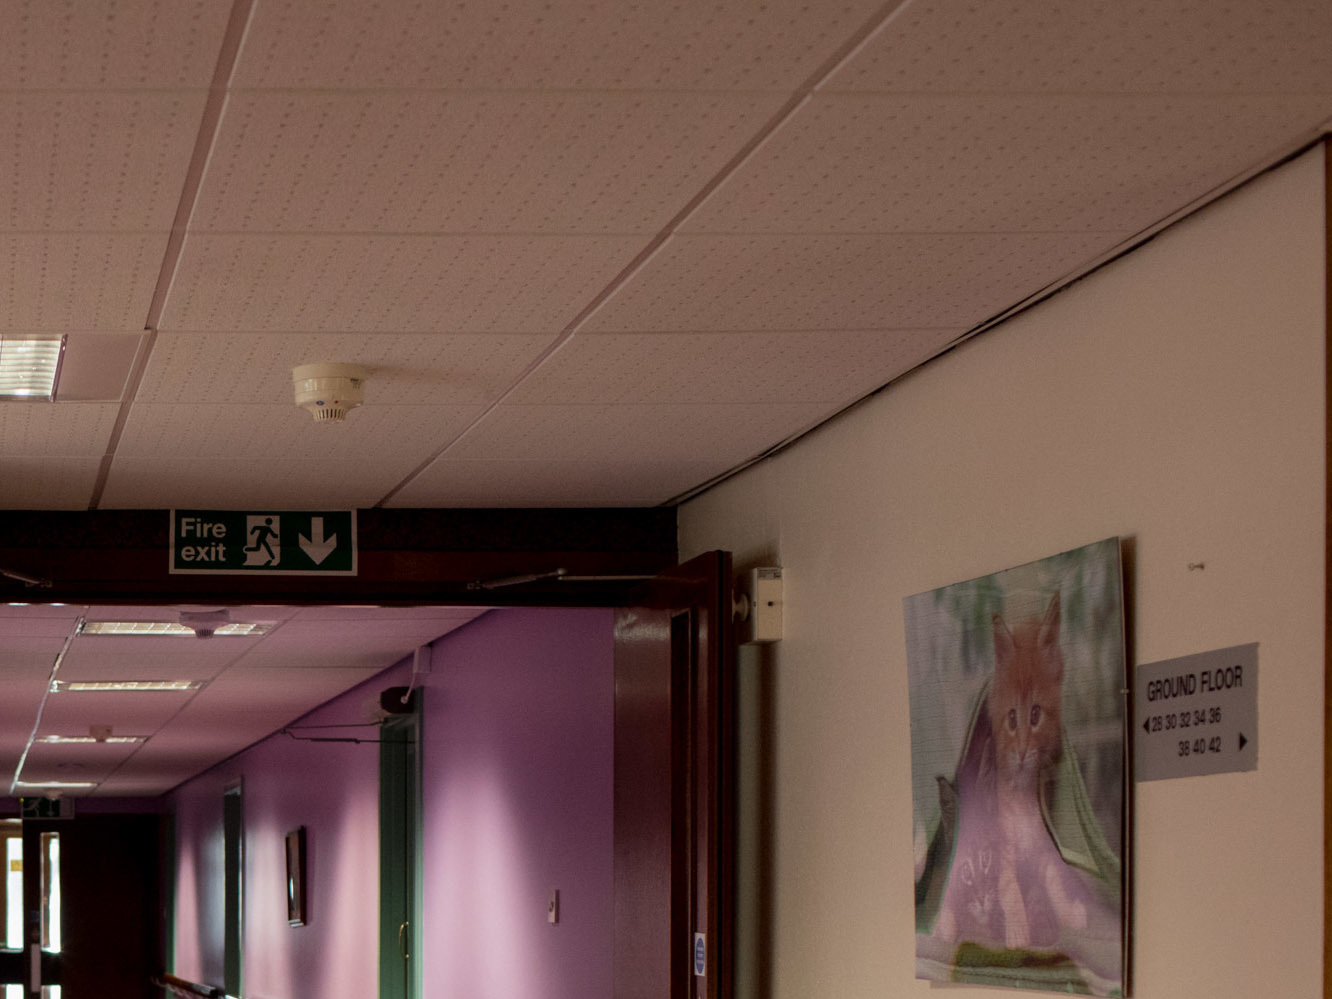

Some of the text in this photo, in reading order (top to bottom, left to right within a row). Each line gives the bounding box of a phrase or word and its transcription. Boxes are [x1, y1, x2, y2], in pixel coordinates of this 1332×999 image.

[181, 518, 226, 537] Fire
[181, 542, 226, 561] exit
[1148, 666, 1243, 701] GROUND FLOOR
[1152, 707, 1221, 732] 28 30 32 34 36
[1178, 737, 1221, 756] 38 40 42
